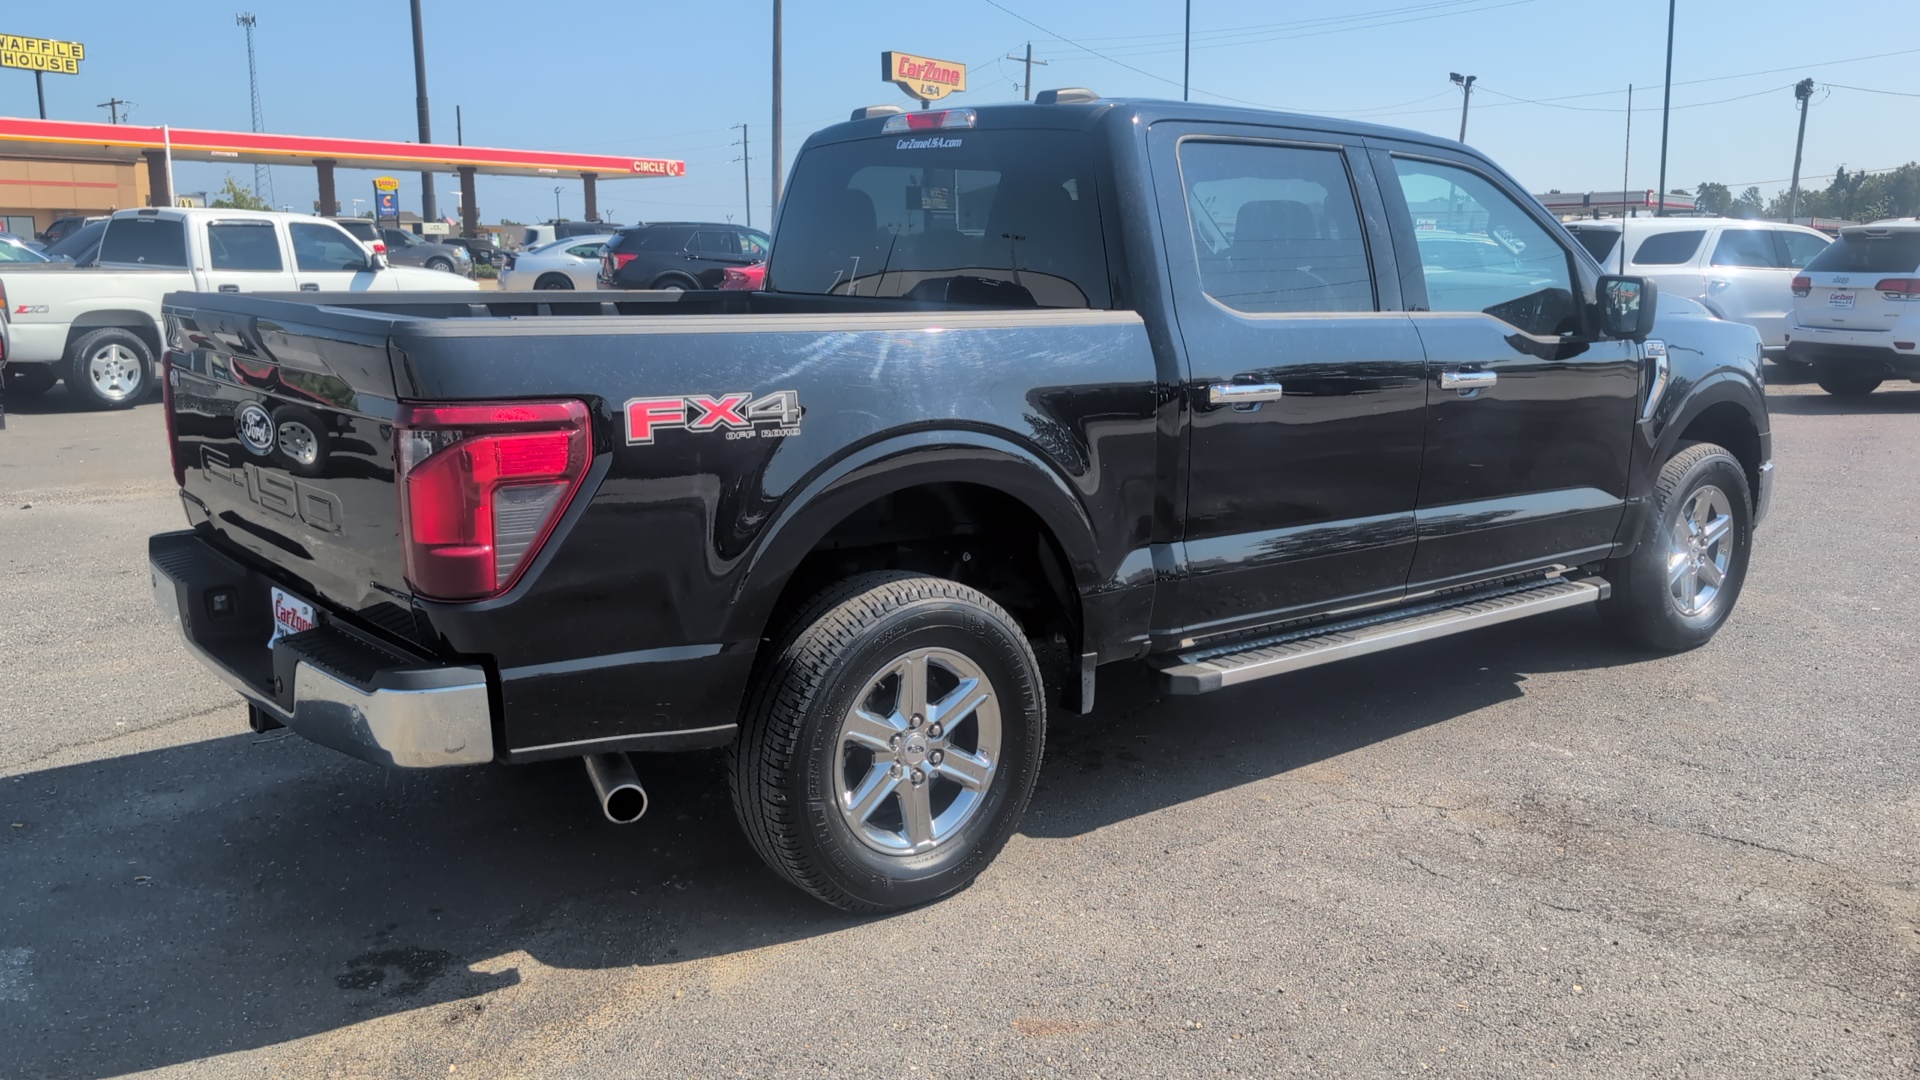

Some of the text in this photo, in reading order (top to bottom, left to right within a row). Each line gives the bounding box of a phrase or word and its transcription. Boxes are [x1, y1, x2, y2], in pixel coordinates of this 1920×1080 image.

[4, 53, 75, 71] HOUSE
[898, 56, 960, 86] CarZone
[920, 84, 940, 96] USA
[896, 138, 962, 149] CarZoneUSA.com
[633, 160, 678, 176] CIRCLE K
[244, 411, 268, 443] Ford
[623, 389, 802, 447] FX4
[725, 427, 801, 440] OFF ROAD
[200, 444, 345, 536] F-150
